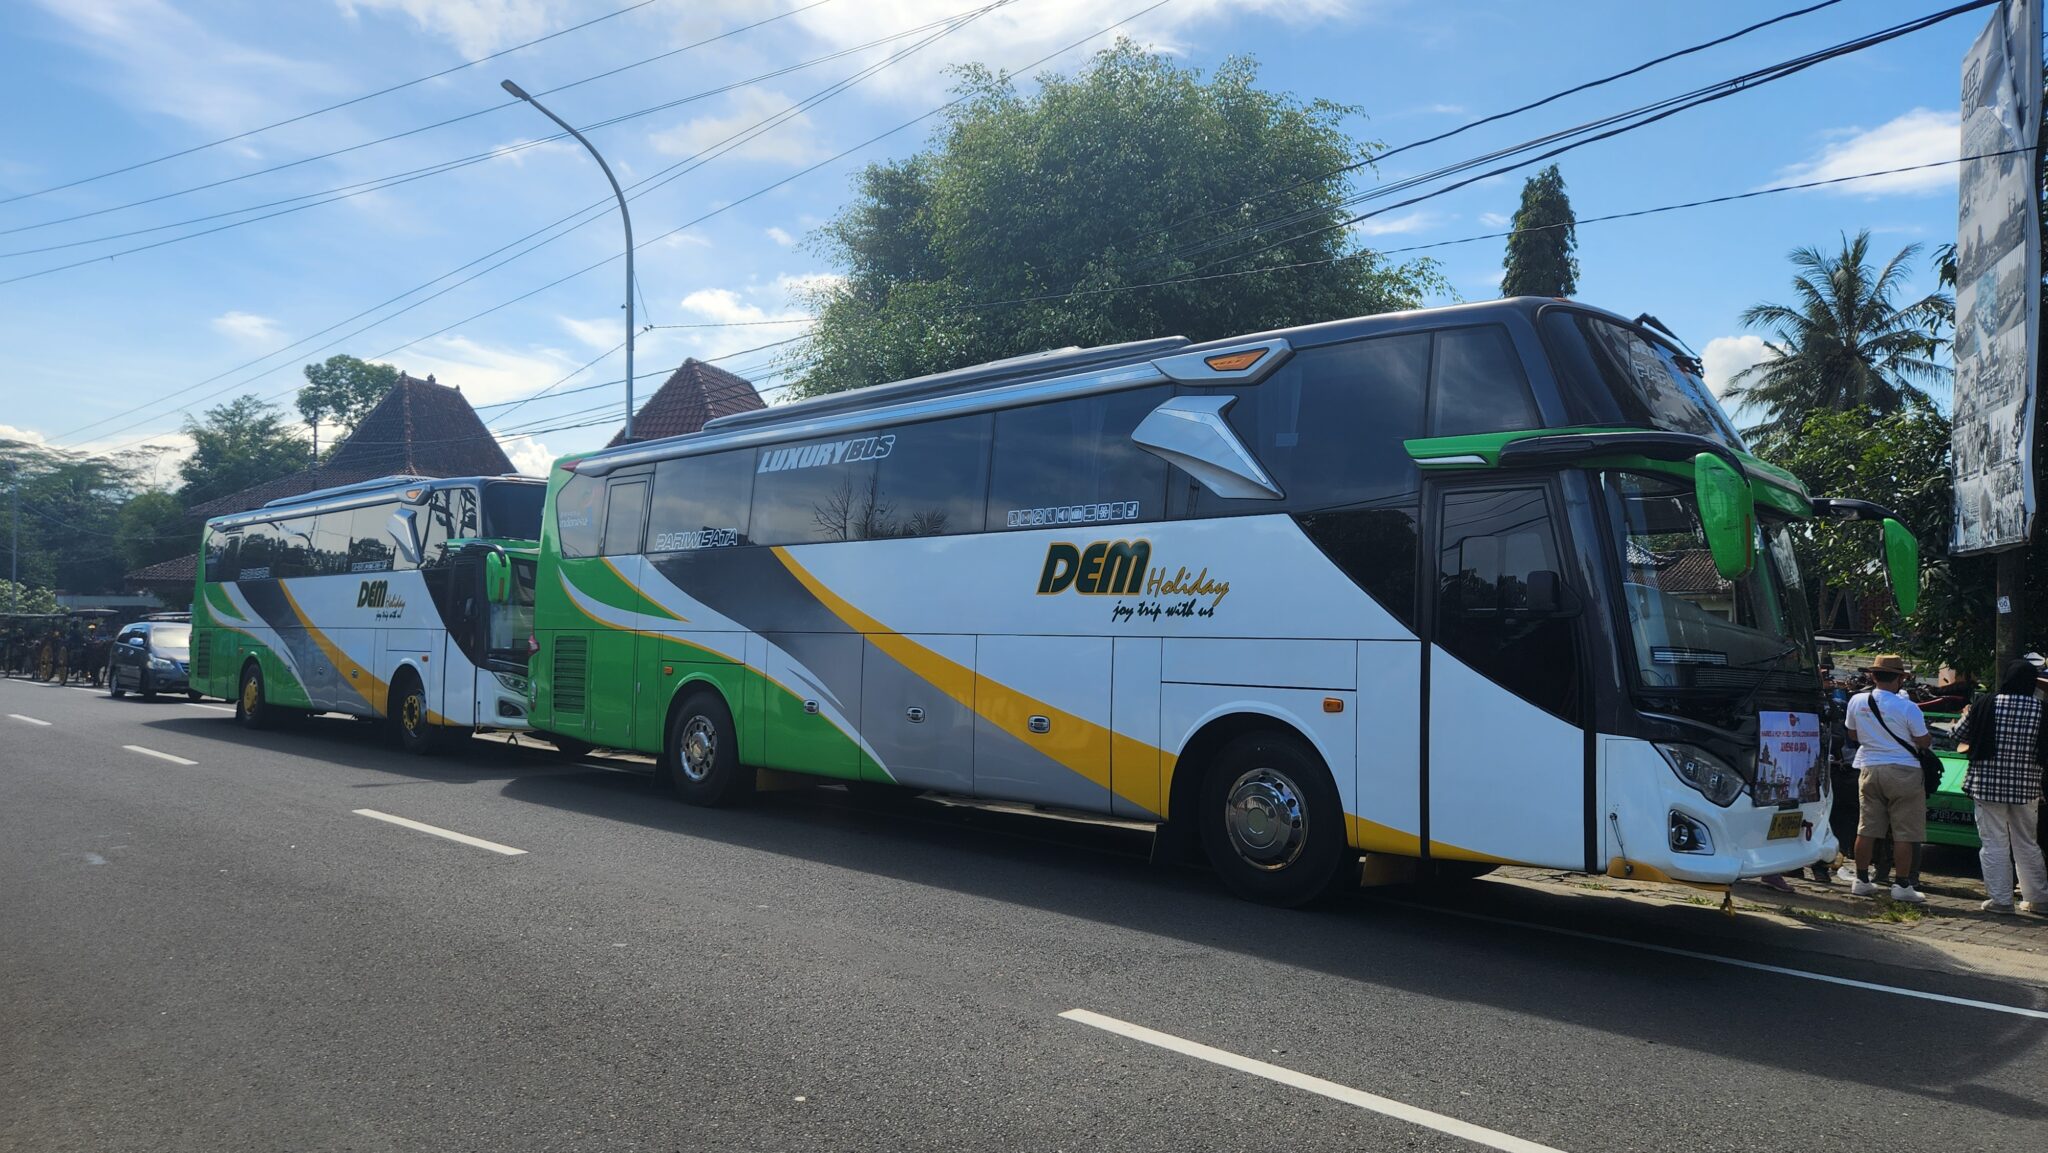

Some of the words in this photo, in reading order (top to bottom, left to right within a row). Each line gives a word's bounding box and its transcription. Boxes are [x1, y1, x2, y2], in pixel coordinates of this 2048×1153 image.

[654, 527, 738, 551] PARIWISATA
[1036, 538, 1153, 596] DEM
[356, 579, 388, 609] DEM
[1147, 566, 1230, 607] Holiday
[1112, 599, 1134, 623] joy
[1137, 600, 1162, 622] trip
[1166, 598, 1195, 618] with
[1199, 605, 1214, 618] us
